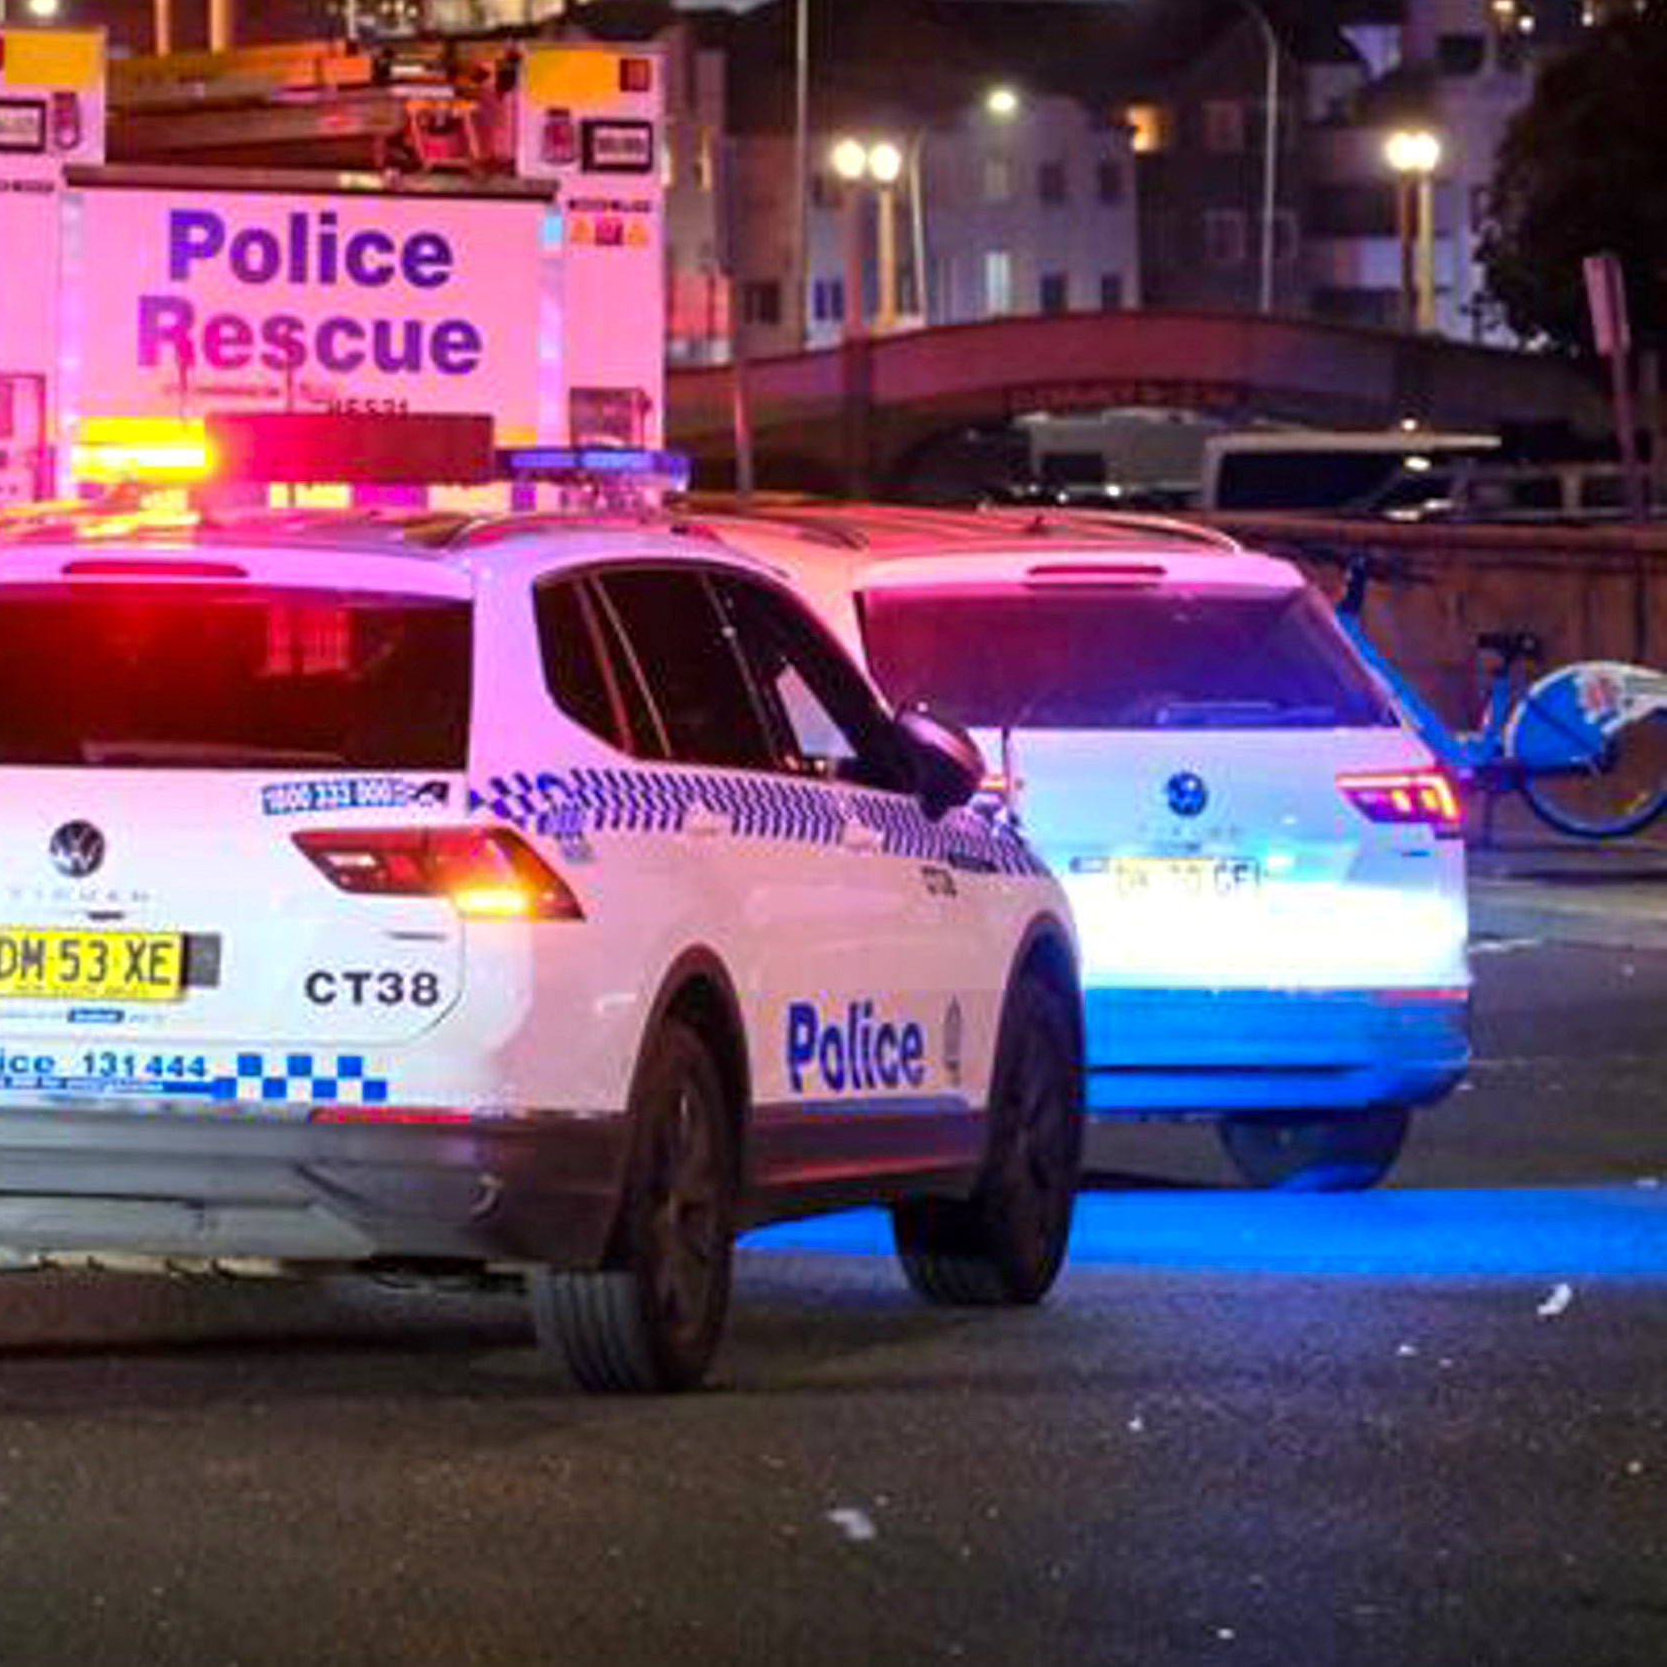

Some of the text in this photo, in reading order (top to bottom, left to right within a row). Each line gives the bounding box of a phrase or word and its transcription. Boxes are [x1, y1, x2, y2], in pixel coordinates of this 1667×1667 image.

[168, 208, 454, 289] Police
[137, 295, 482, 374] Rescue
[58, 938, 109, 983] 53
[124, 940, 174, 986] XE
[305, 970, 439, 1006] CT38
[787, 1001, 924, 1094] Police
